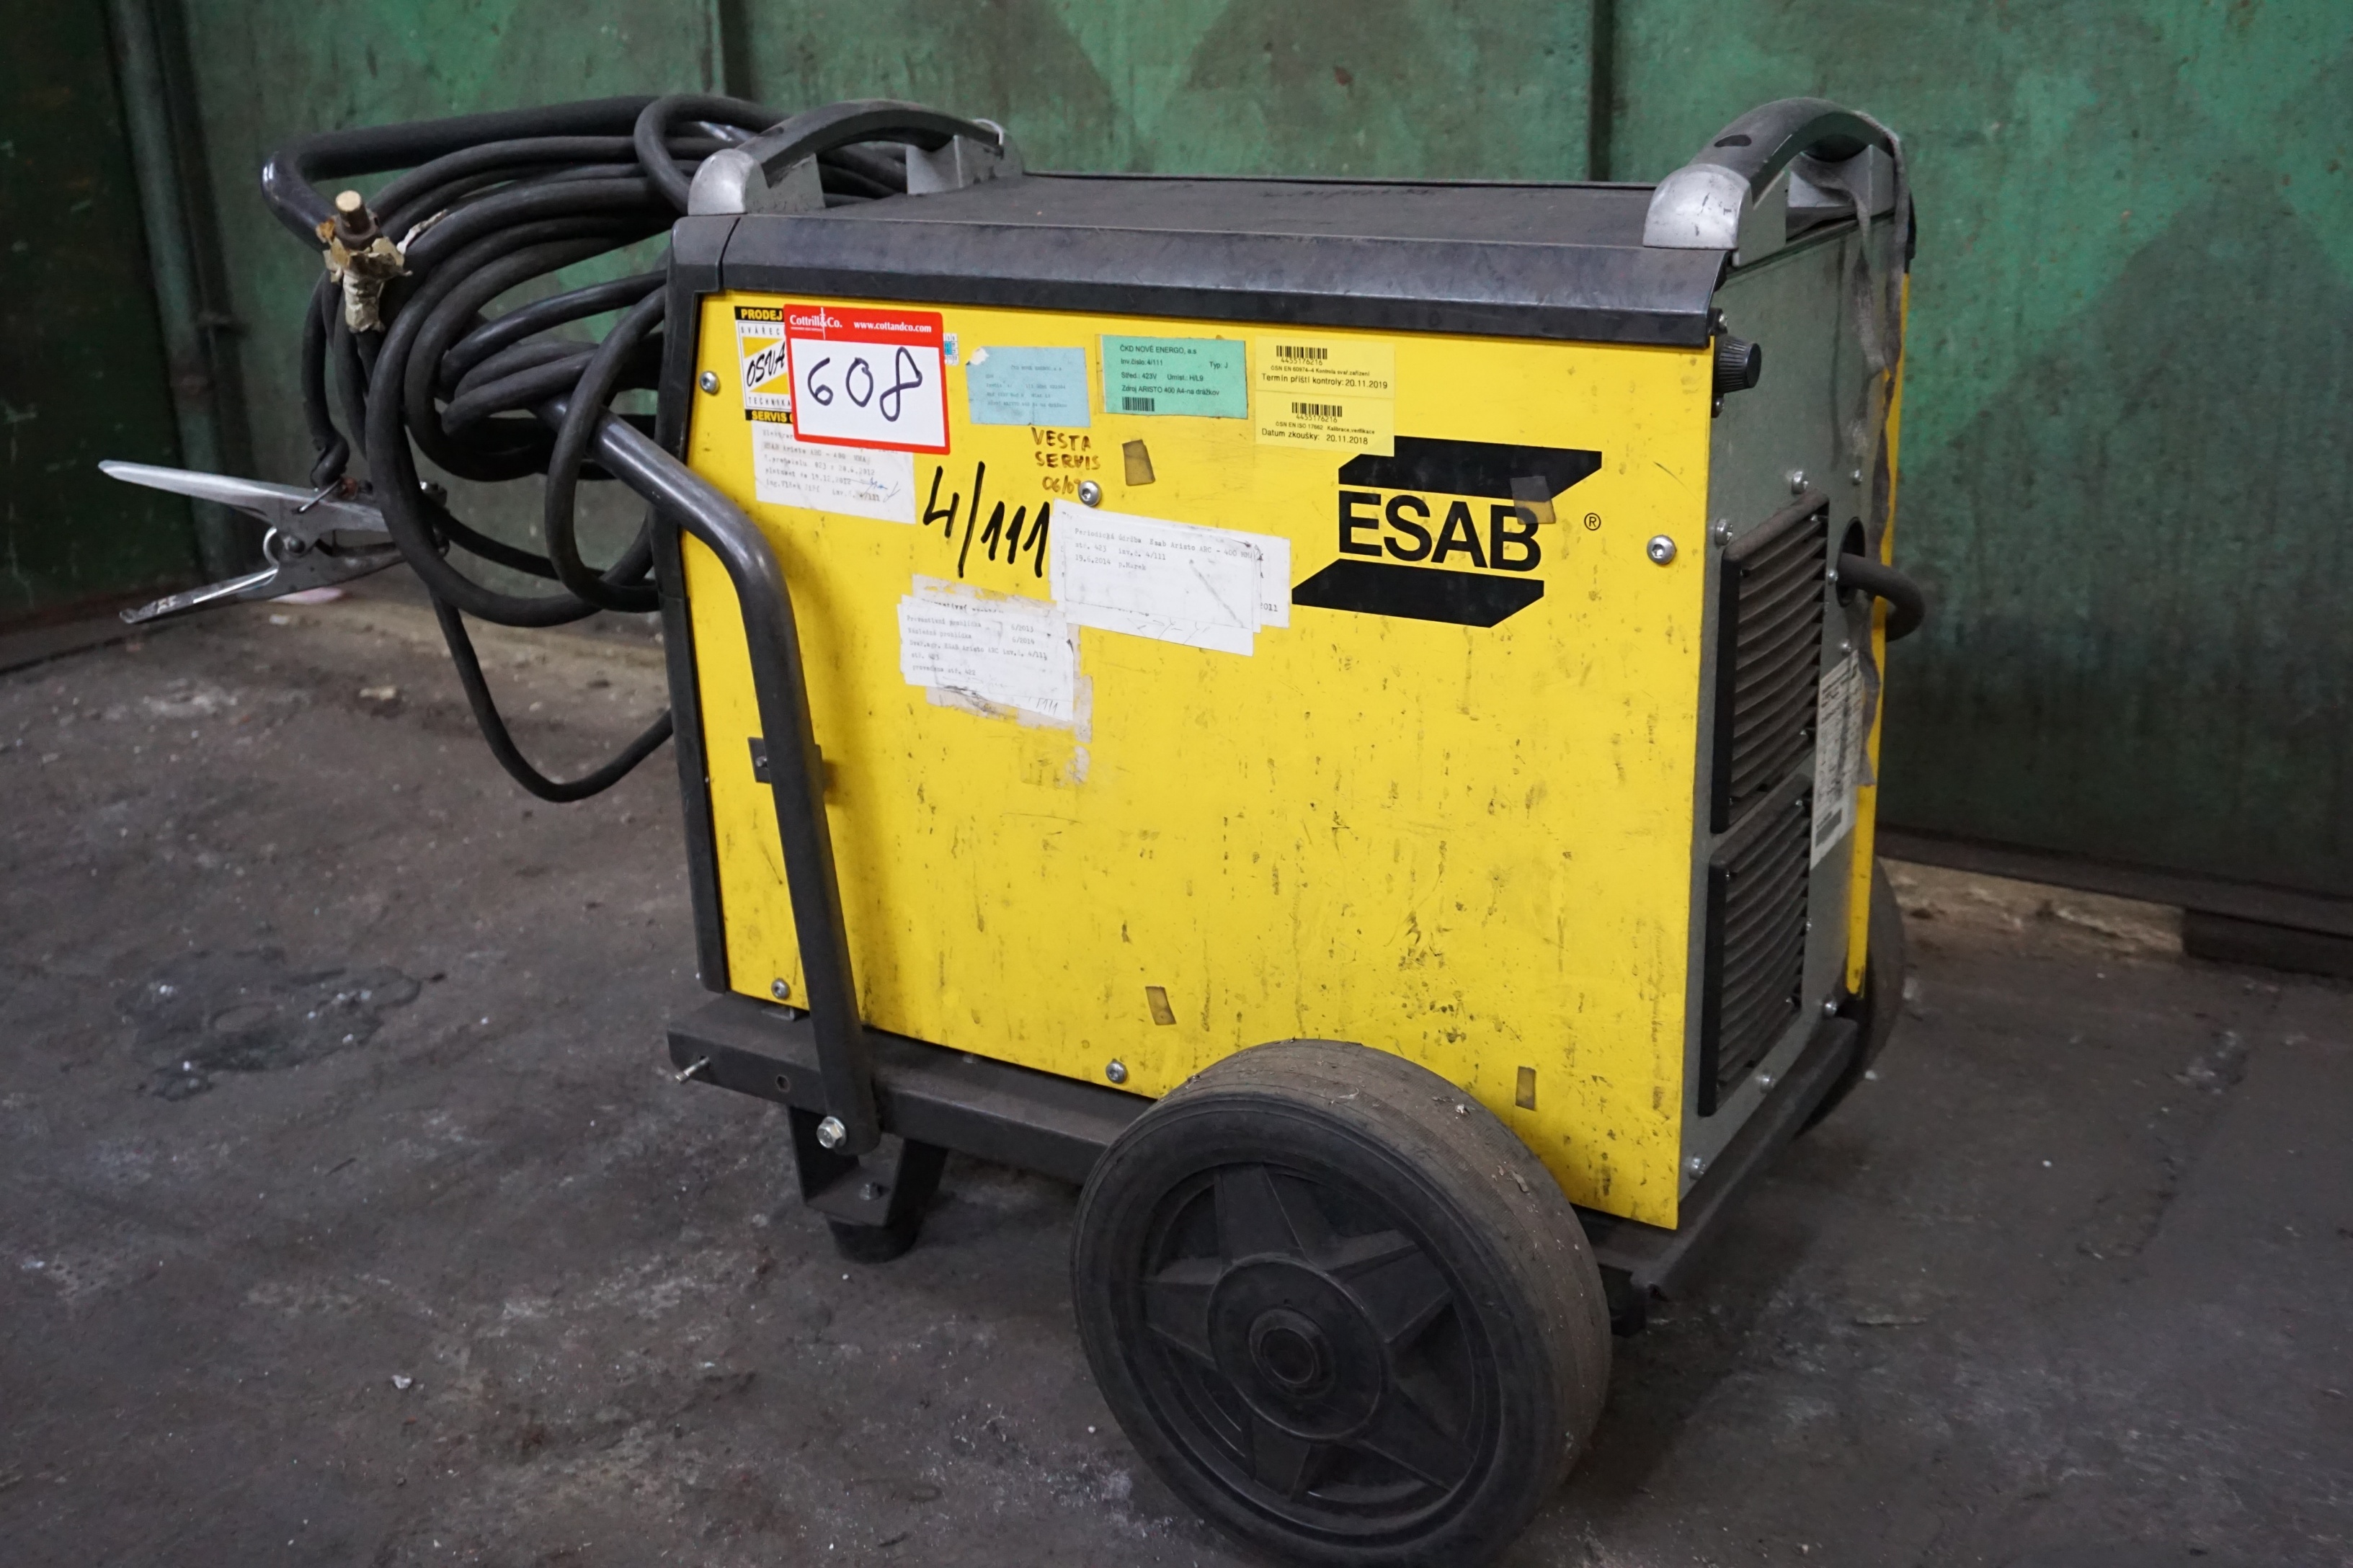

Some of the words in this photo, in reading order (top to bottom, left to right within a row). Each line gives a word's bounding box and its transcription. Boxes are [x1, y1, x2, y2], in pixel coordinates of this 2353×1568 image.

[741, 308, 783, 320] PRODEJ
[854, 321, 932, 333] www.cottandco.com
[1135, 344, 1154, 353] NOVÉ
[747, 342, 786, 387] OSVA
[807, 346, 923, 422] 608
[1262, 373, 1288, 382] Termín
[1291, 374, 1310, 383] příští
[1312, 377, 1344, 386] kontroly:
[1345, 379, 1388, 389] 20.11.2019
[752, 411, 787, 422] SERVIS
[1296, 414, 1338, 423] 4455176216
[1031, 427, 1091, 451] VESTA
[1262, 428, 1286, 437] Datum
[1288, 430, 1320, 441] zkoušky:
[1326, 434, 1369, 445] 20.11.2018
[1035, 451, 1100, 470] SERVIS
[922, 461, 1050, 579] 4/111
[1338, 489, 1542, 572] ESAB
[1075, 527, 1115, 540] Periodická
[1118, 533, 1142, 544] údržba
[1149, 538, 1167, 548] Esab
[1170, 541, 1196, 551] Aristo
[1075, 554, 1111, 565] 19.6.2014
[1094, 543, 1107, 553] 423
[1145, 551, 1166, 561] 4/111
[1011, 624, 1034, 633] 6/2013
[1012, 636, 1035, 646] 6/2014
